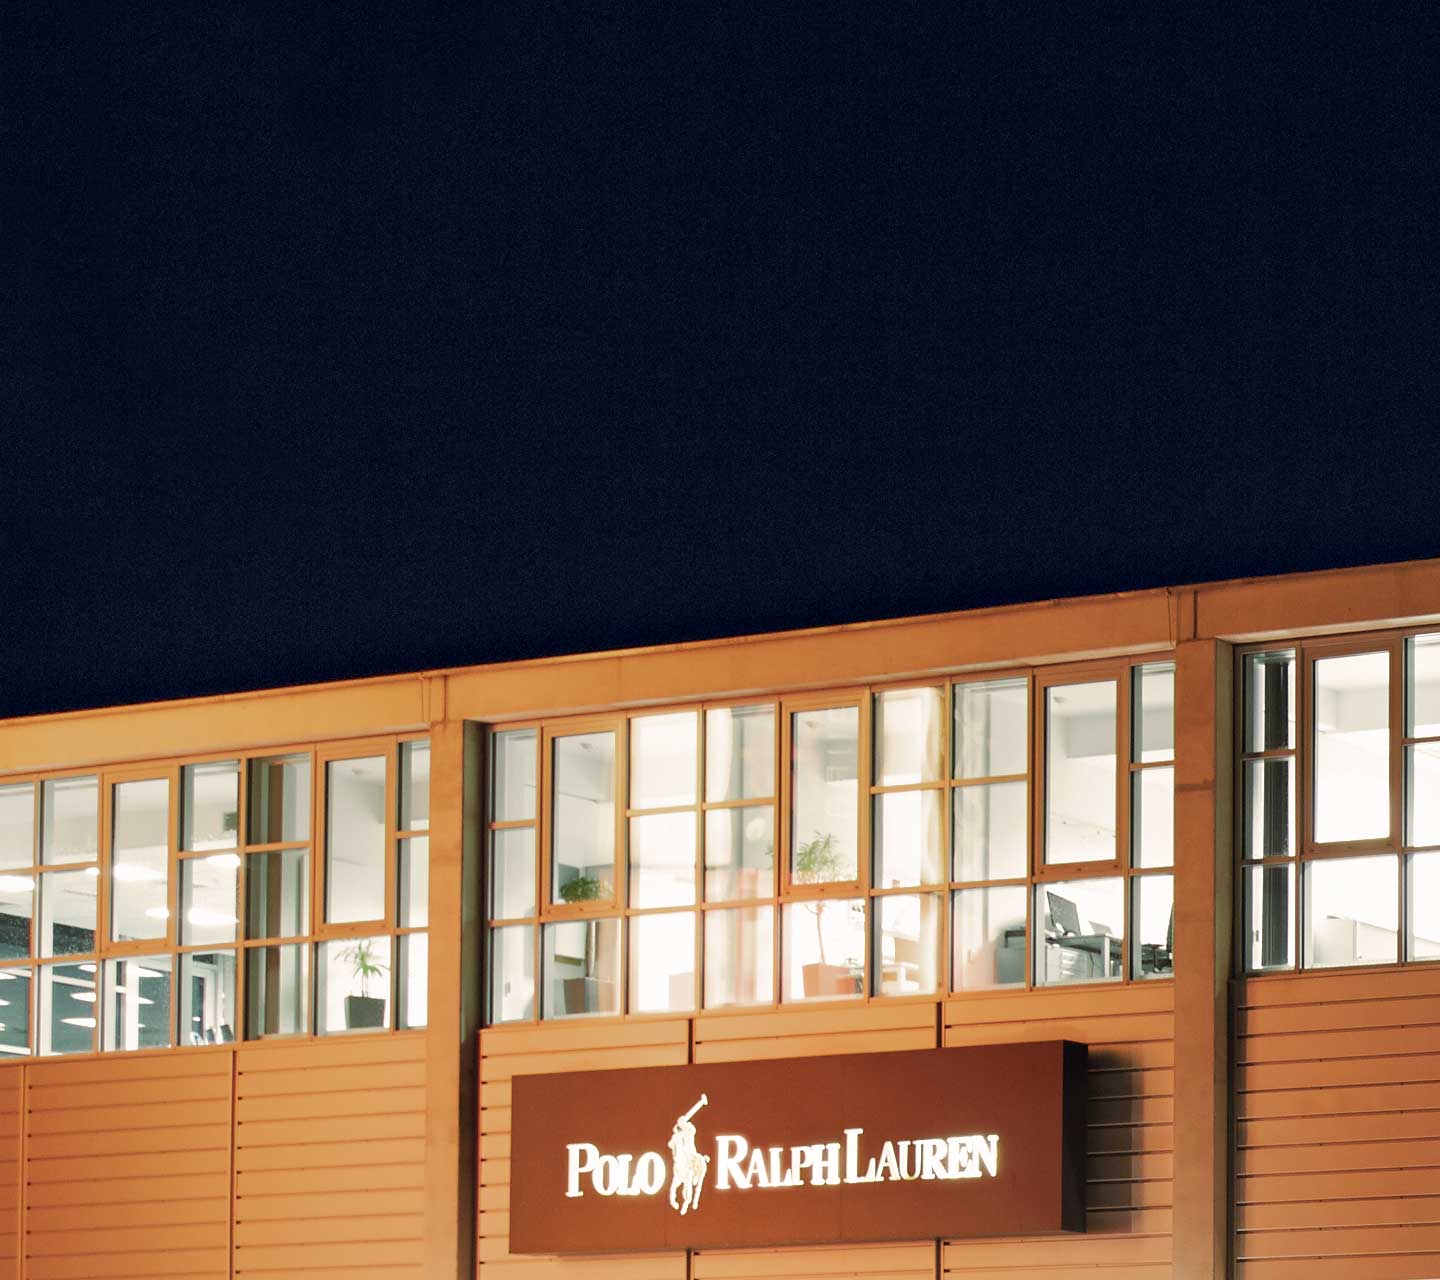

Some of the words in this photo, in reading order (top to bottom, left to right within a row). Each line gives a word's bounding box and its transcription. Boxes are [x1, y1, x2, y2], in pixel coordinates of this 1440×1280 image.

[565, 1142, 666, 1198] POLO
[715, 1134, 841, 1190] RALPH
[843, 1128, 999, 1184] LAUREN
